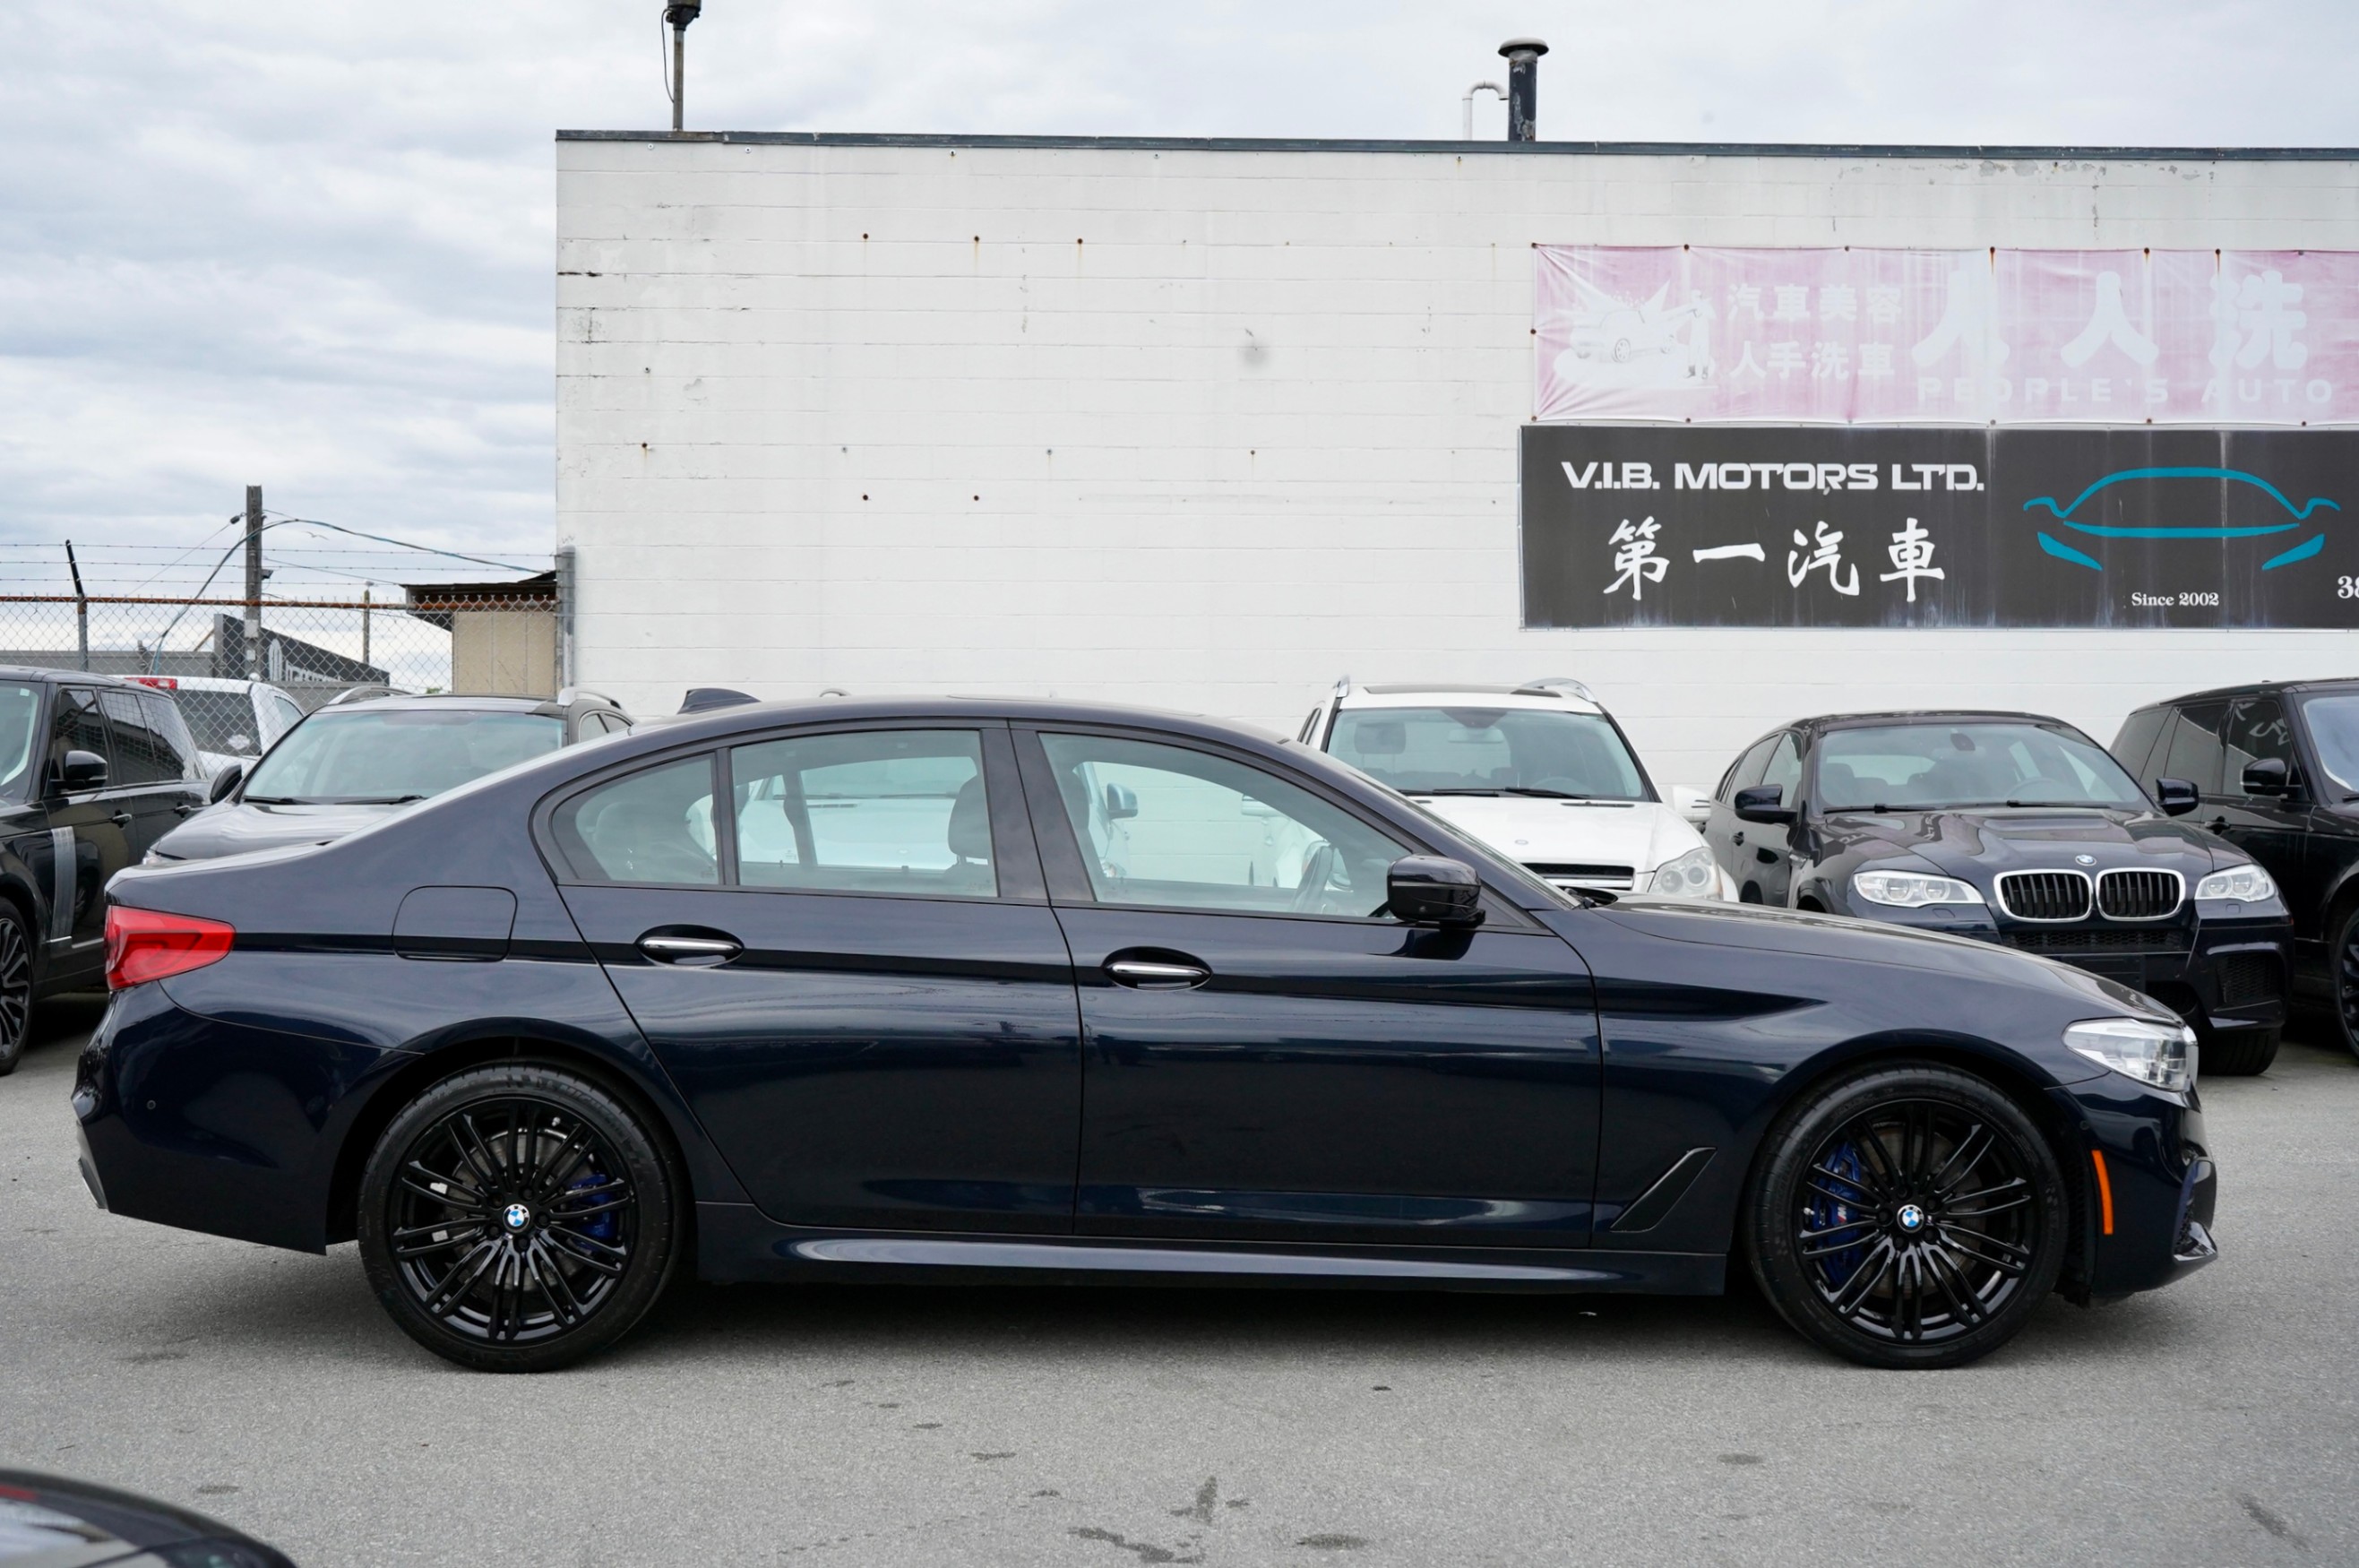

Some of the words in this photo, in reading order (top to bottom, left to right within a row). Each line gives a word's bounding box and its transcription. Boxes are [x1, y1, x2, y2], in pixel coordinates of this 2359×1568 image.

[1727, 282, 1902, 324] 汽車美容
[1728, 340, 1896, 380] 人手洗車
[2201, 378, 2333, 403] AUTO
[1561, 461, 1661, 489] V.I.B.
[1675, 463, 1879, 490] MOTORS
[1891, 464, 1985, 491] LTD.
[1603, 515, 1945, 602] 第一汽車
[2131, 592, 2175, 607] Since
[2179, 592, 2220, 607] 2002
